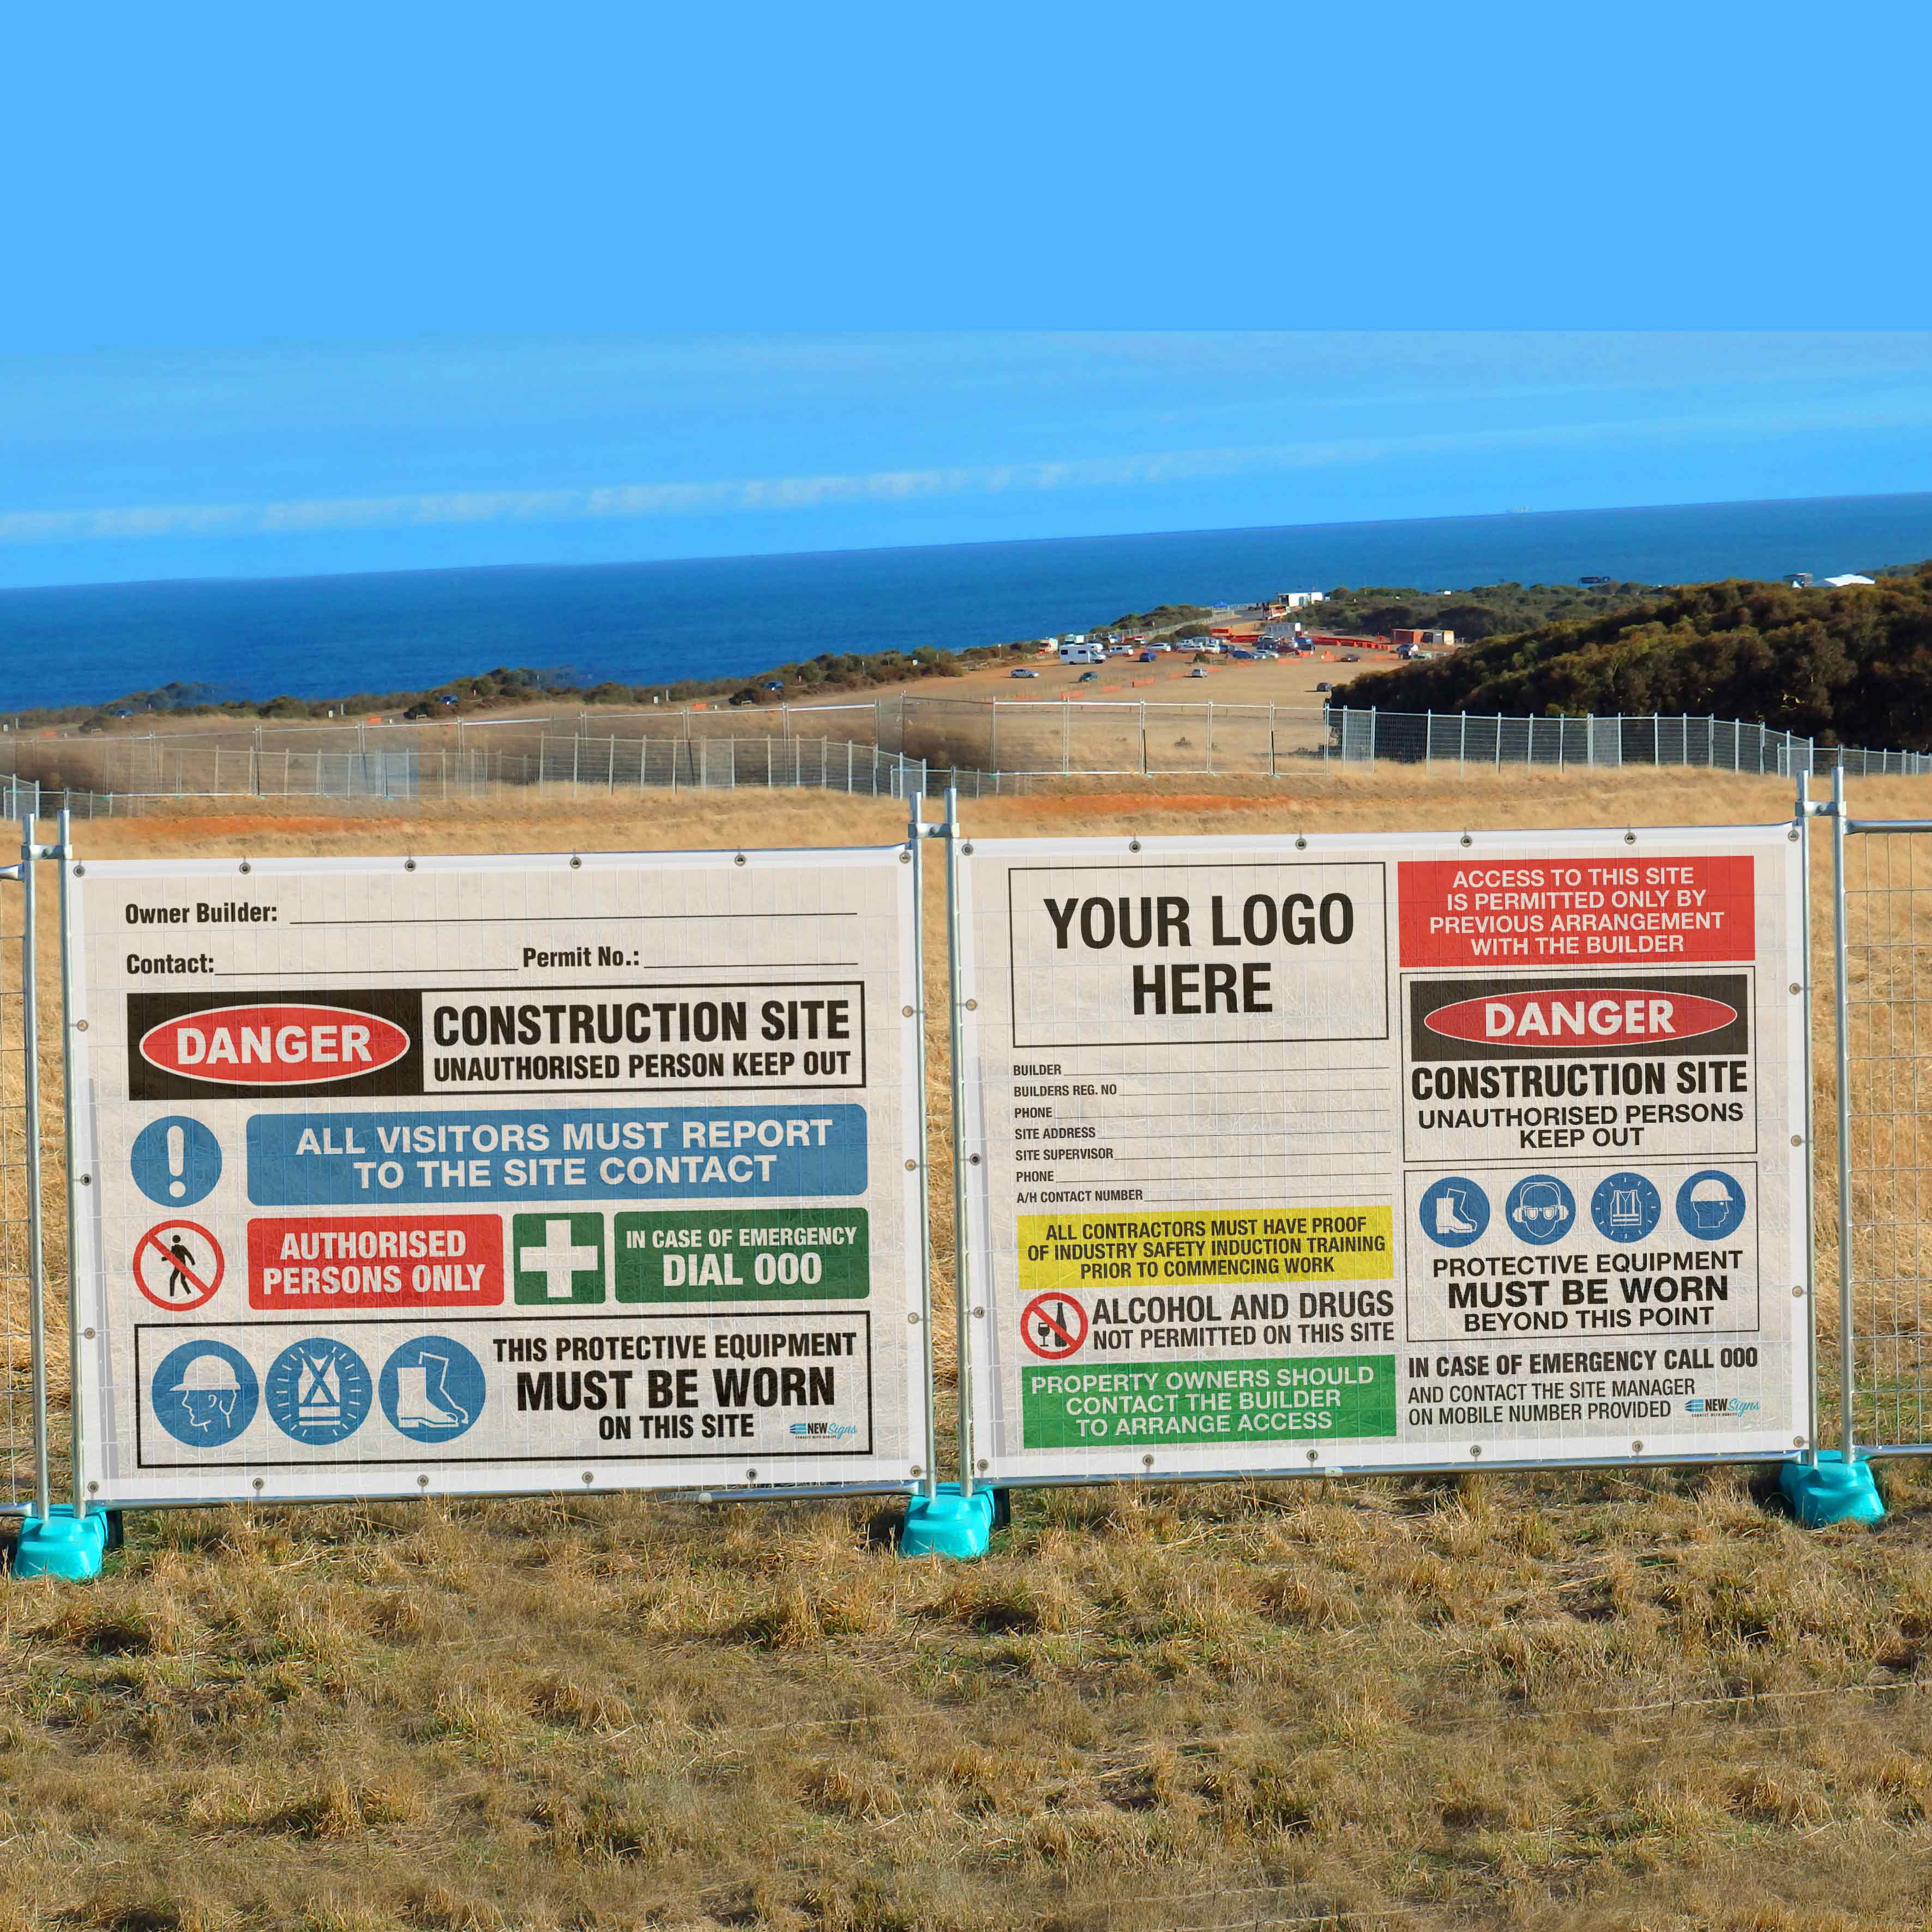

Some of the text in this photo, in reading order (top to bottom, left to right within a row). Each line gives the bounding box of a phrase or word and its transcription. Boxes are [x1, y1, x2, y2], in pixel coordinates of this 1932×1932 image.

[1453, 868, 1693, 888] ACCESS TO THIS SITE
[1448, 889, 1706, 911] IS PERMITTED ONLY BY
[126, 902, 276, 924] Owner Builder:
[1043, 893, 1353, 949] YOUR LOGO
[1431, 912, 1724, 934] PREVIOUS ARRANGEMENT
[523, 947, 639, 967] Permit No.:
[1471, 935, 1683, 955] WITH THE BUILDER
[127, 954, 213, 974] Contact:
[1133, 963, 1272, 1015] HERE
[434, 1000, 849, 1046] CONSTRUCTION SITE
[1486, 1000, 1676, 1037] DANGER
[178, 1025, 372, 1064] DANGER
[435, 1051, 850, 1081] UNAUTHORISED PERSON KEEP OUT
[1014, 1064, 1061, 1075] BUILDER
[1014, 1084, 1116, 1097] BUILDERS REG. NO
[1412, 1061, 1747, 1100] CONSTRUCTION SITE
[1015, 1108, 1052, 1118] PHONE
[1419, 1103, 1743, 1129] UNAUTHORISED PERSONS
[296, 1119, 833, 1154] ALL VISITORS MUST REPORT
[1015, 1127, 1095, 1139] SITE ADDRESS
[1520, 1128, 1644, 1148] KEEP OUT
[1016, 1148, 1113, 1160] SITE SUPERVISOR
[353, 1155, 777, 1188] TO THE SITE CONTACT
[1016, 1171, 1054, 1182] PHONE
[1017, 1190, 1142, 1203] A/H CONTACT NUMBER
[627, 1227, 857, 1248] IN CASE OF EMERGENCY
[1046, 1217, 1366, 1240] ALL CONTRACTORS MUST HAVE PROOF
[280, 1230, 466, 1260] AUTHORISED
[1028, 1236, 1385, 1261] OF INDUSTRY SAFETY INDUCTION TRAINING
[663, 1253, 822, 1286] DIAL 000
[1081, 1257, 1334, 1279] PRIOR TO COMMENCING WORK
[1434, 1250, 1743, 1277] PROTECTIVE EQUIPMENT
[264, 1265, 485, 1295] PERSONS ONLY
[1449, 1275, 1728, 1308] MUST BE WORN
[1092, 1290, 1393, 1325] ALCOHOL AND DRUGS
[1465, 1307, 1714, 1332] BEYOND THIS POINT
[493, 1332, 856, 1362] THIS PROTECTIVE EQUIPMENT
[1094, 1322, 1394, 1350] NOT PERMITTED ON THIS SITE
[1409, 1347, 1757, 1377] IN CASE OF EMERGENCY CALL 000
[517, 1367, 834, 1411] MUST BE WORN
[1032, 1367, 1374, 1394] PROPERTY OWNERS SHOULD
[1409, 1379, 1694, 1404] AND CONTACT THE SITE MANAGER
[1067, 1389, 1340, 1415] CONTACT THE BUILDER
[1409, 1401, 1671, 1425] ON MOBILE NUMBER PROVIDED
[1706, 1398, 1760, 1417] NEW Signs
[599, 1414, 754, 1440] ON THIS SITE
[808, 1422, 856, 1440] NEW Signs
[1076, 1411, 1332, 1436] TO ARRANGE ACCESS
